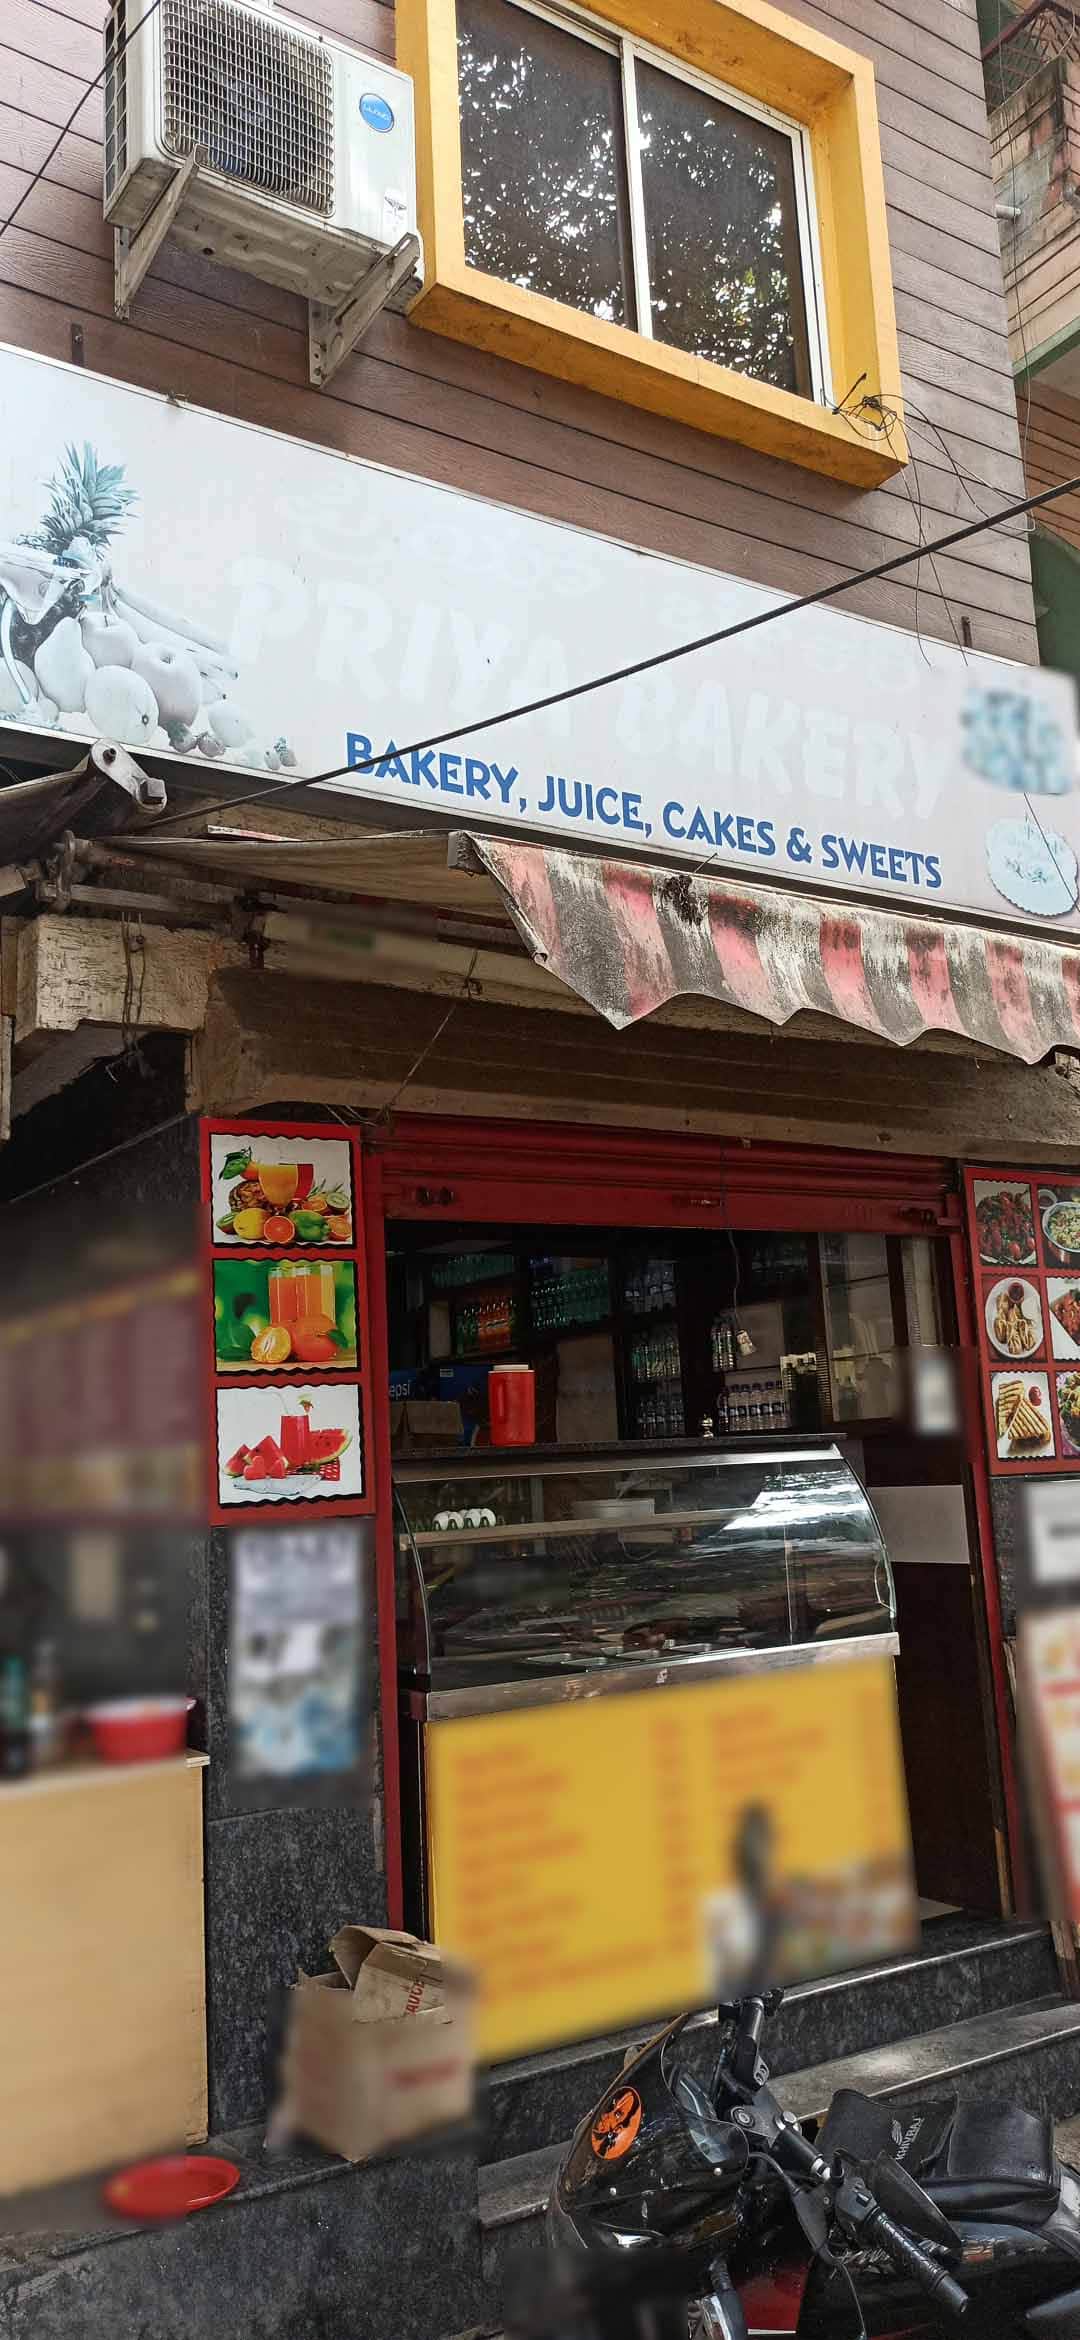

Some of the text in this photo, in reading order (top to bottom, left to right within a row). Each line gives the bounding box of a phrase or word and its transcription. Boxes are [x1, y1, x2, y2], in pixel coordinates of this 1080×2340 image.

[230, 555, 571, 738] PRIYA
[611, 655, 955, 821] BAKERY
[346, 732, 942, 888] BAKERY, JUICE, CAKES & SWEETS
[389, 1379, 411, 1400] epsi
